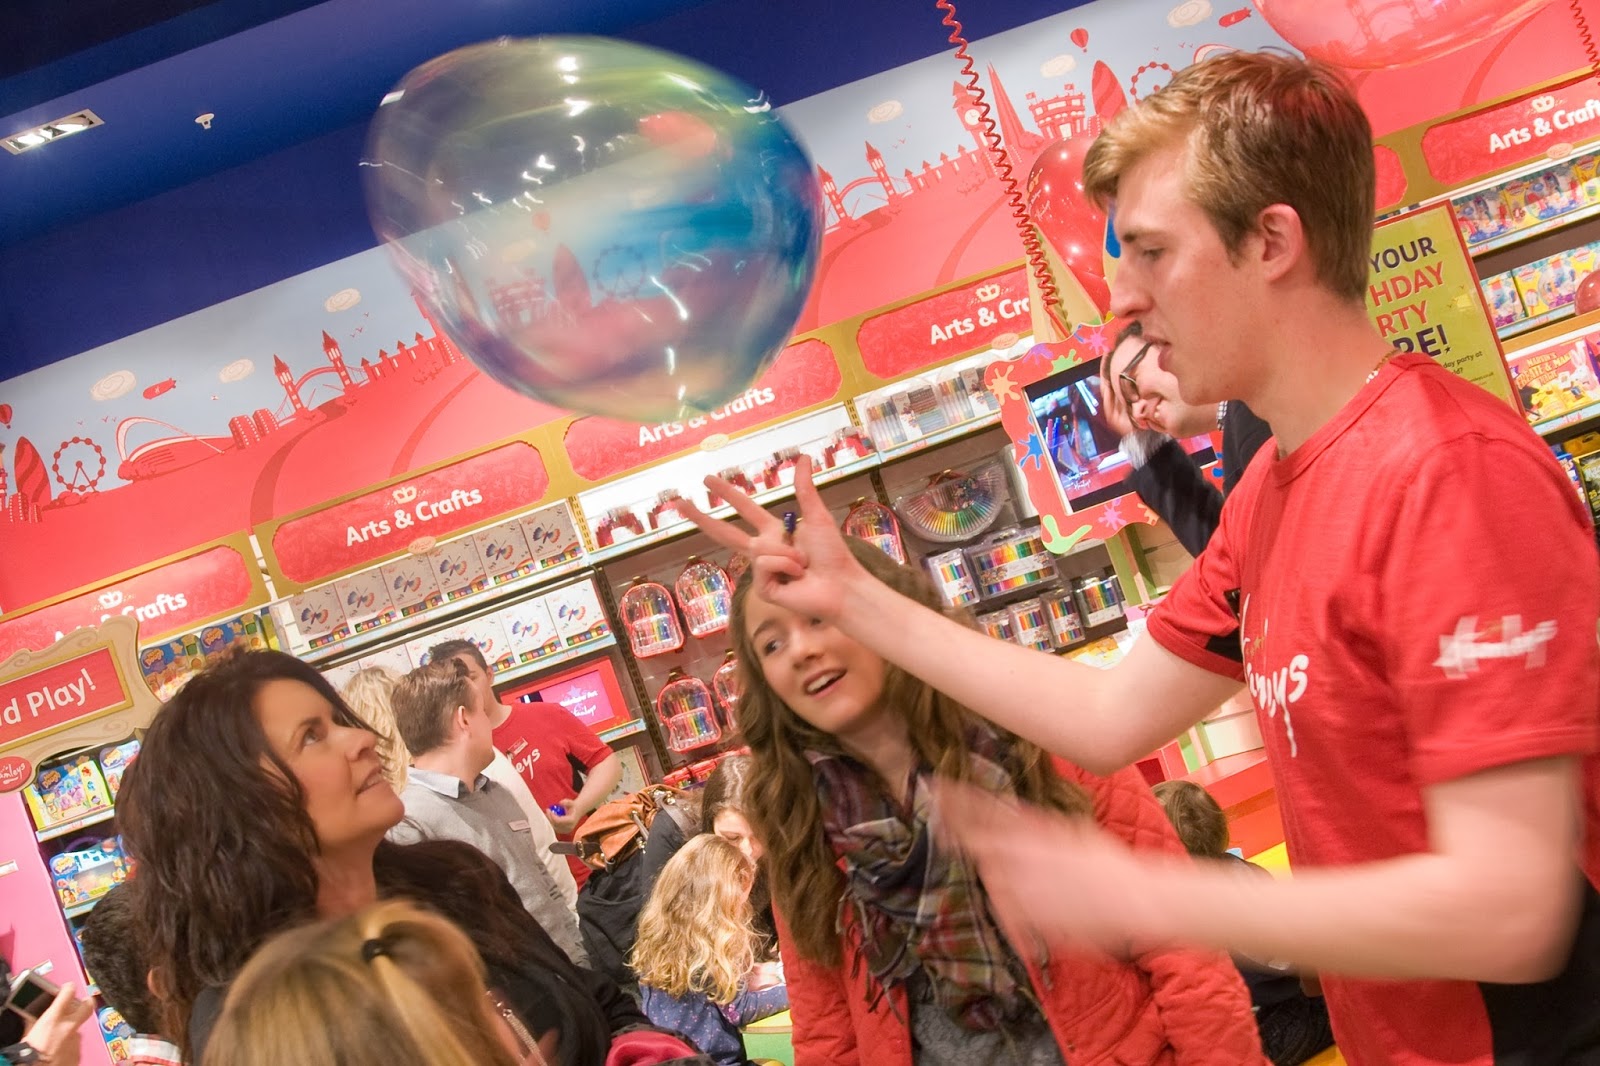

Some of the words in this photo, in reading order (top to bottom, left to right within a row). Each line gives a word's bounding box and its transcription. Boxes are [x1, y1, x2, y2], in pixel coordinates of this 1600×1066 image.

[1489, 127, 1531, 154] Arts
[1533, 117, 1553, 137] &
[1553, 98, 1600, 130] Craft
[1370, 236, 1437, 274] YOUR
[1369, 261, 1443, 307] HDAY
[930, 317, 975, 345] Arts
[978, 307, 997, 327] &
[1376, 300, 1428, 338] RTY
[1393, 324, 1448, 357] RE!
[1443, 361, 1456, 369] day
[638, 420, 684, 447] Arts
[346, 519, 391, 547] Arts
[394, 509, 414, 529] &
[415, 488, 483, 521] Crafts
[0, 698, 21, 725] d
[26, 668, 97, 718] Play!
[515, 748, 541, 780] eys
